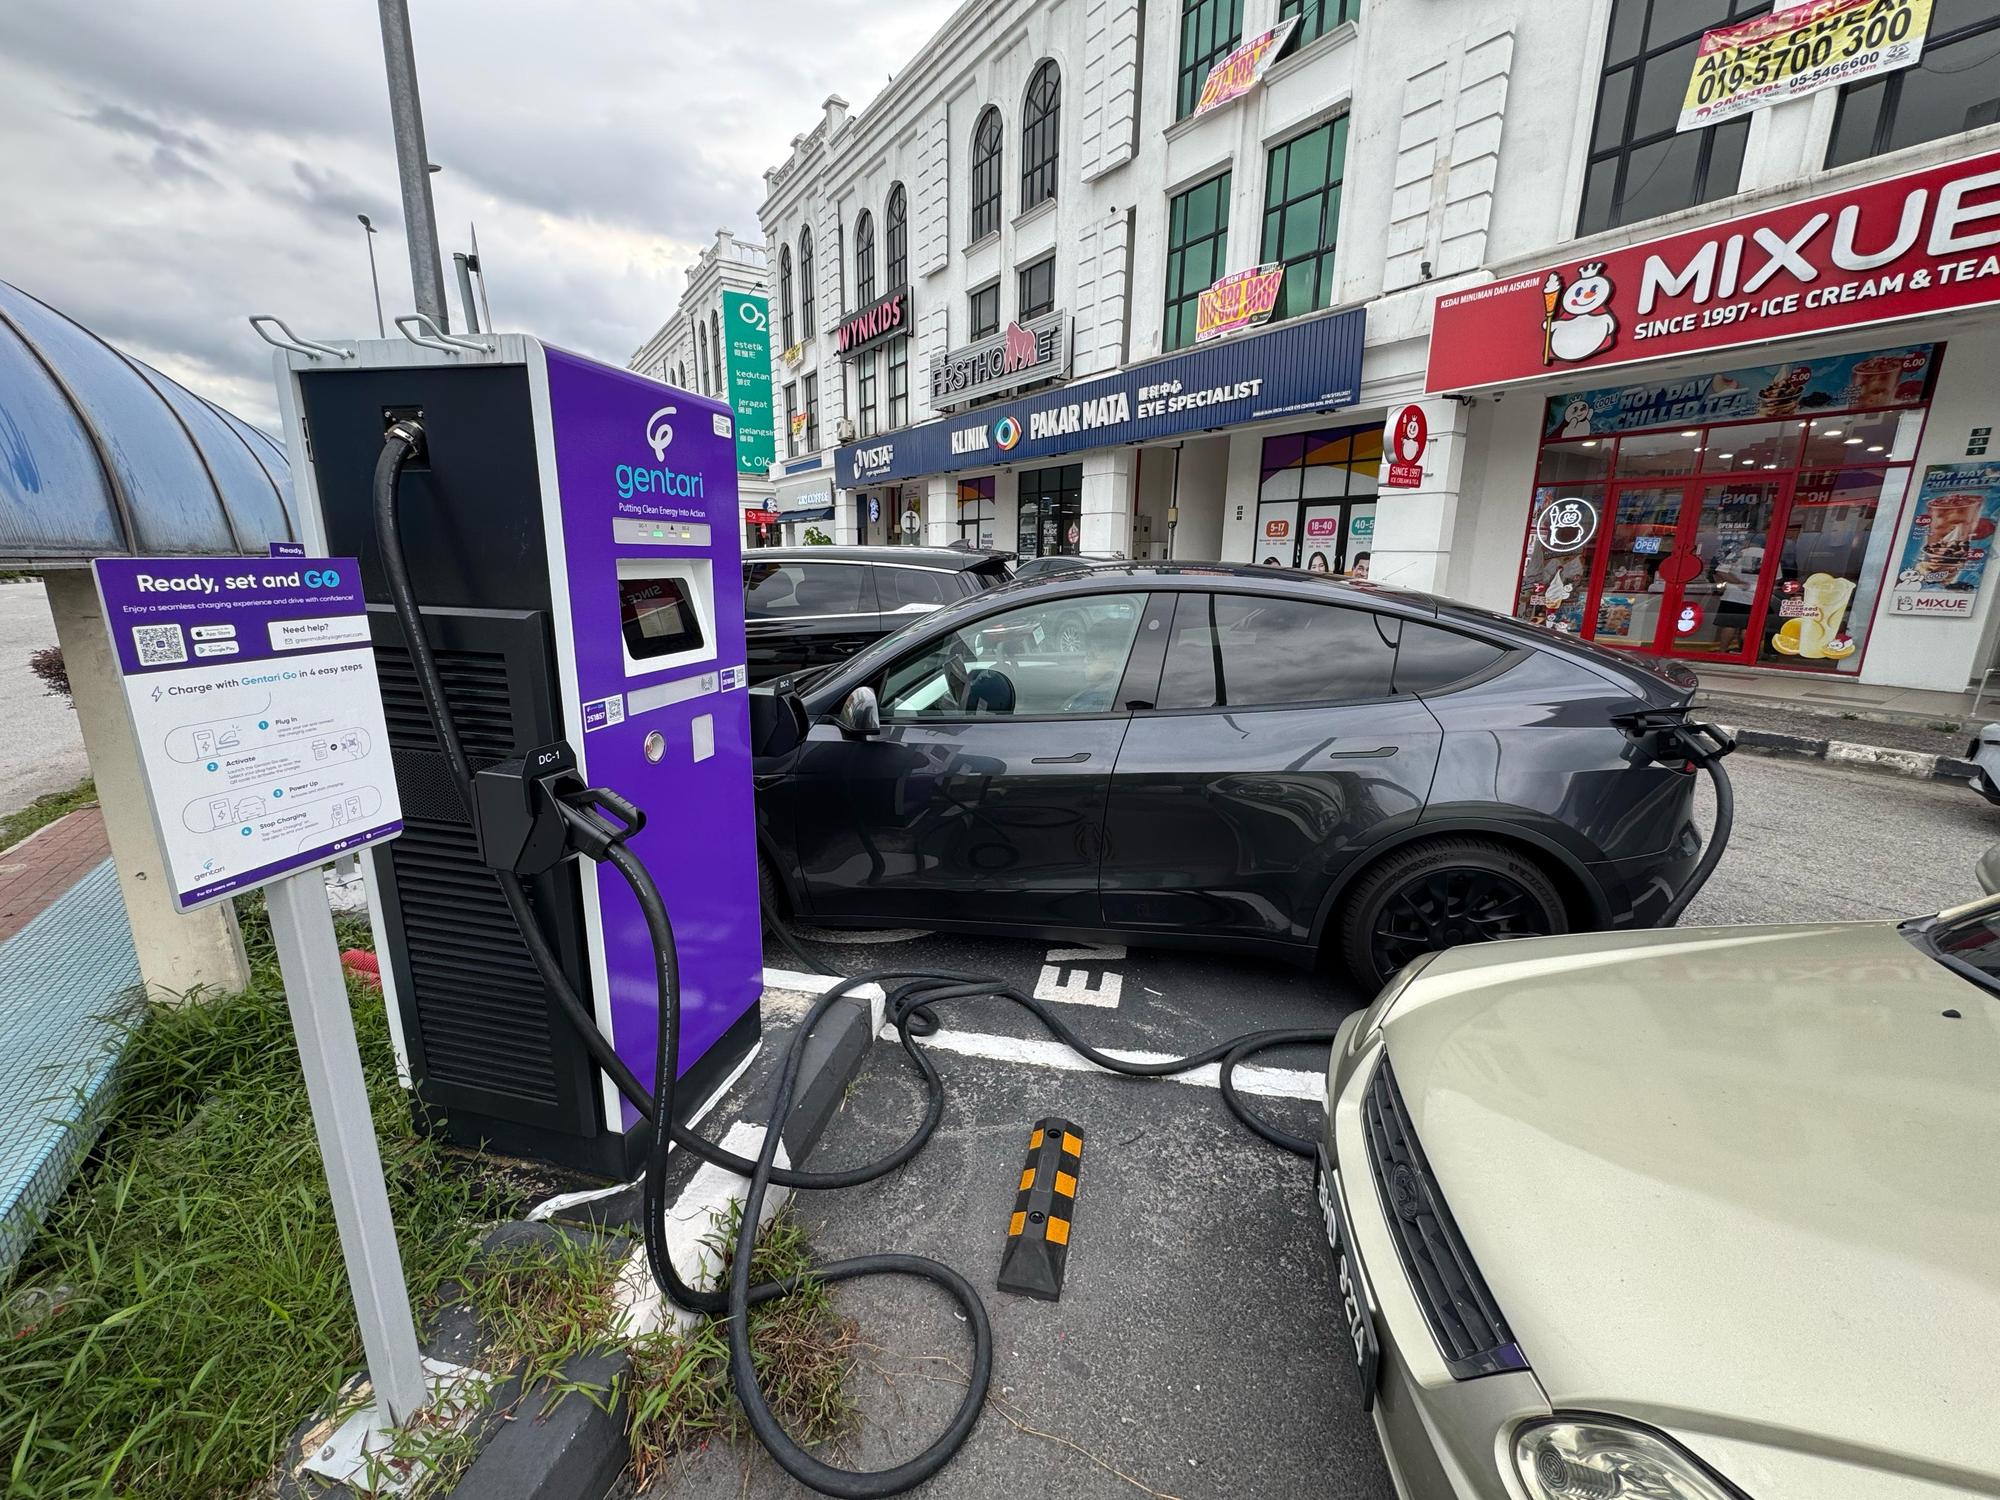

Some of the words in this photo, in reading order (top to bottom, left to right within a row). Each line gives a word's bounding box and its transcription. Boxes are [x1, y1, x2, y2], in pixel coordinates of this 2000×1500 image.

[1697, 39, 1775, 76] ALEX
[1788, 0, 1908, 46] CHEA
[1697, 35, 1832, 104] 019-5700
[1842, 7, 1911, 57] 300
[1790, 52, 1880, 88] 05-5466600
[1713, 83, 1783, 109] ORIENTAL
[1637, 171, 2000, 315] MIXUE
[1440, 297, 1460, 308] KEDAI
[1460, 289, 1493, 304] MINUMAN
[1494, 286, 1508, 296] DAN
[1508, 277, 1540, 292] AISKRIM
[1634, 313, 1696, 341] SINCE
[1805, 272, 1905, 309] CREAM
[1909, 268, 1932, 290] &
[1937, 255, 2000, 283] TEA
[837, 295, 901, 353] WYNKIDS
[1902, 358, 1926, 368] 6.00
[736, 369, 770, 380] kedutan
[1791, 372, 1810, 382] 5.00
[1138, 400, 1166, 418] EYE
[1168, 379, 1263, 413] SPECIALIST
[1620, 389, 1662, 410] HOT
[1666, 378, 1713, 401] DAY
[952, 425, 989, 455] KLINIK
[1030, 404, 1081, 440] PAKAR
[1083, 392, 1131, 430] MATA
[1616, 402, 1700, 429] CHILLED
[615, 464, 704, 499] gentari
[1392, 466, 1408, 476] SINCE
[1409, 467, 1421, 478] 1997
[619, 503, 642, 515] Putting
[642, 504, 659, 514] Clean
[660, 507, 678, 517] Energy
[1270, 523, 1285, 532] 5-17
[1311, 521, 1333, 530] 18-40
[280, 547, 303, 555] Ready,
[1635, 540, 1658, 551] OPEN
[137, 574, 219, 594] Ready,
[225, 574, 257, 590] set
[262, 571, 300, 588] and
[123, 605, 147, 613] Enjoy
[158, 602, 196, 611] seamless
[197, 601, 231, 610] charging
[233, 599, 272, 608] experience
[320, 594, 354, 602] confidence!
[1916, 598, 1968, 608] MIXUE
[283, 626, 305, 634] Need
[308, 623, 329, 633] help?
[168, 684, 213, 696] Charge
[215, 679, 239, 689] with
[241, 673, 281, 686] Gentari
[282, 671, 297, 680] Go
[299, 670, 308, 678] in
[310, 668, 316, 676] 4
[318, 666, 339, 675] easy
[340, 662, 363, 673] steps
[275, 717, 290, 726] Plug
[226, 755, 256, 767] Activate
[538, 750, 560, 765] DC-1
[289, 784, 309, 793] Power
[259, 820, 276, 830] Stop
[277, 811, 307, 826] Charging
[194, 866, 225, 881] gentari
